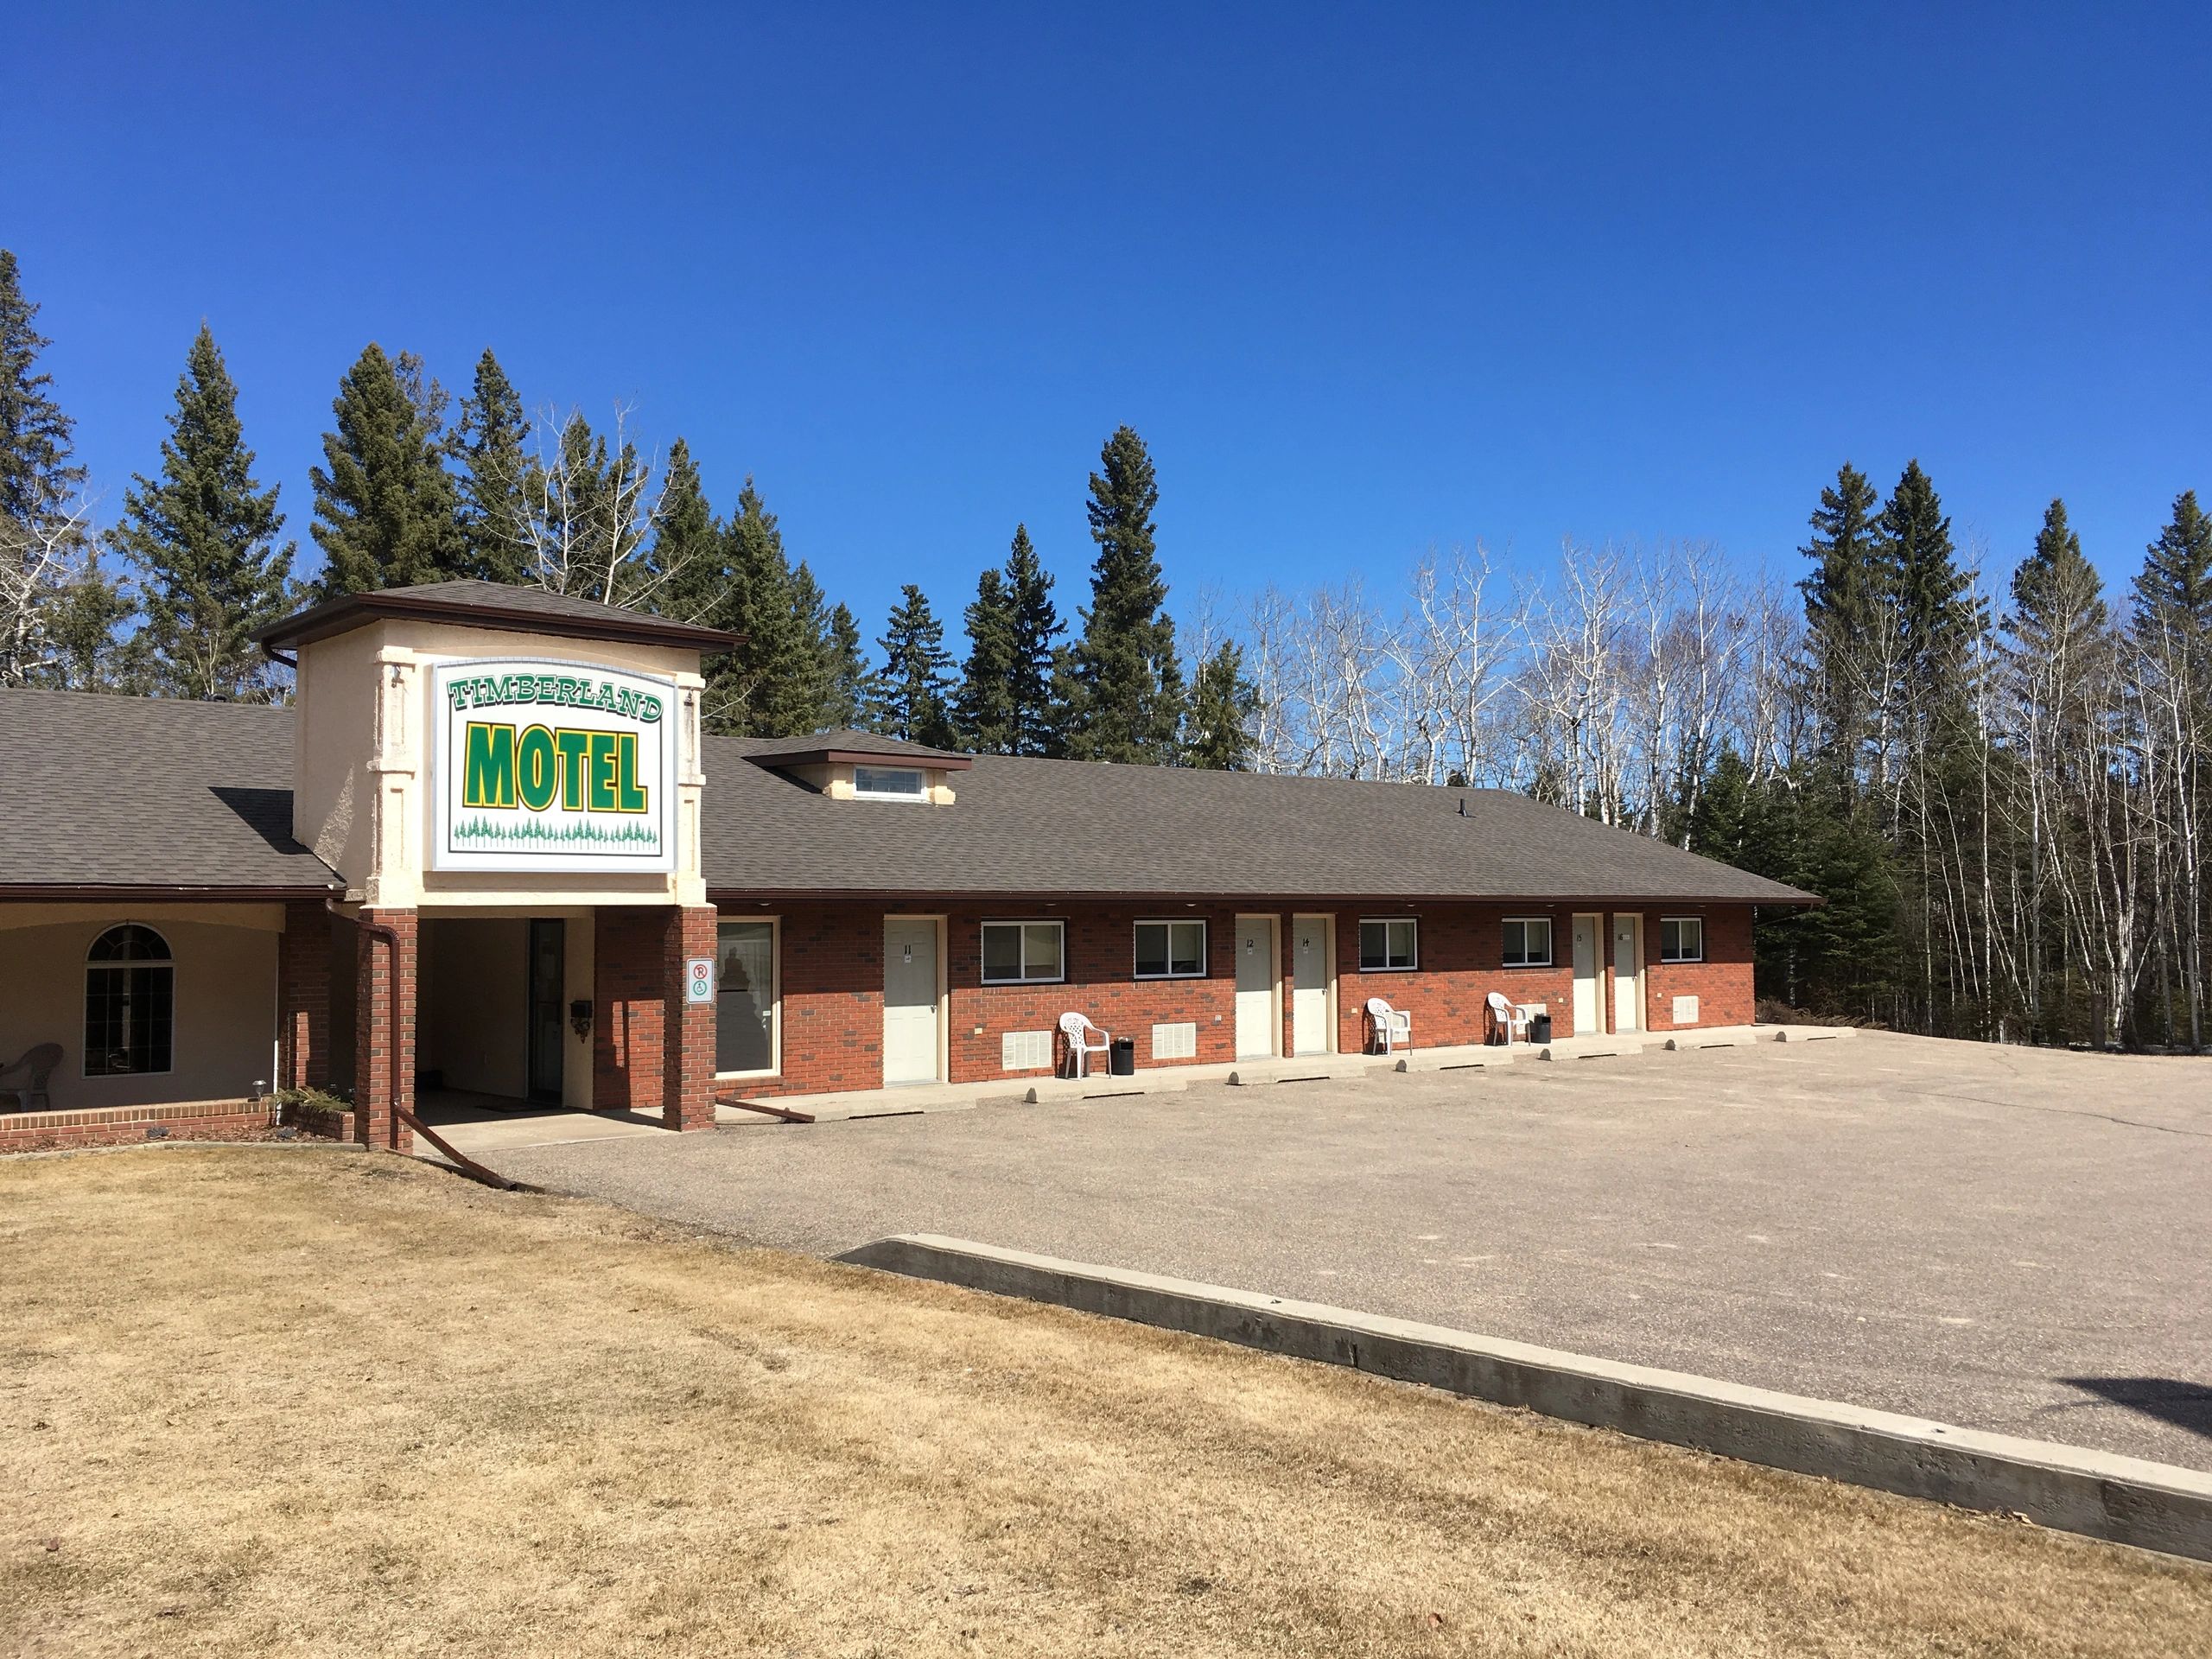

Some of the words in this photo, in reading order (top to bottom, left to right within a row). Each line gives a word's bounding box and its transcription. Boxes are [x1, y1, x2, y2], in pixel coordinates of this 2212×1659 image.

[447, 673, 664, 723] TIMBERLAND
[462, 721, 648, 814] MOTEL
[904, 944, 911, 955] 11
[1246, 939, 1254, 948] 12
